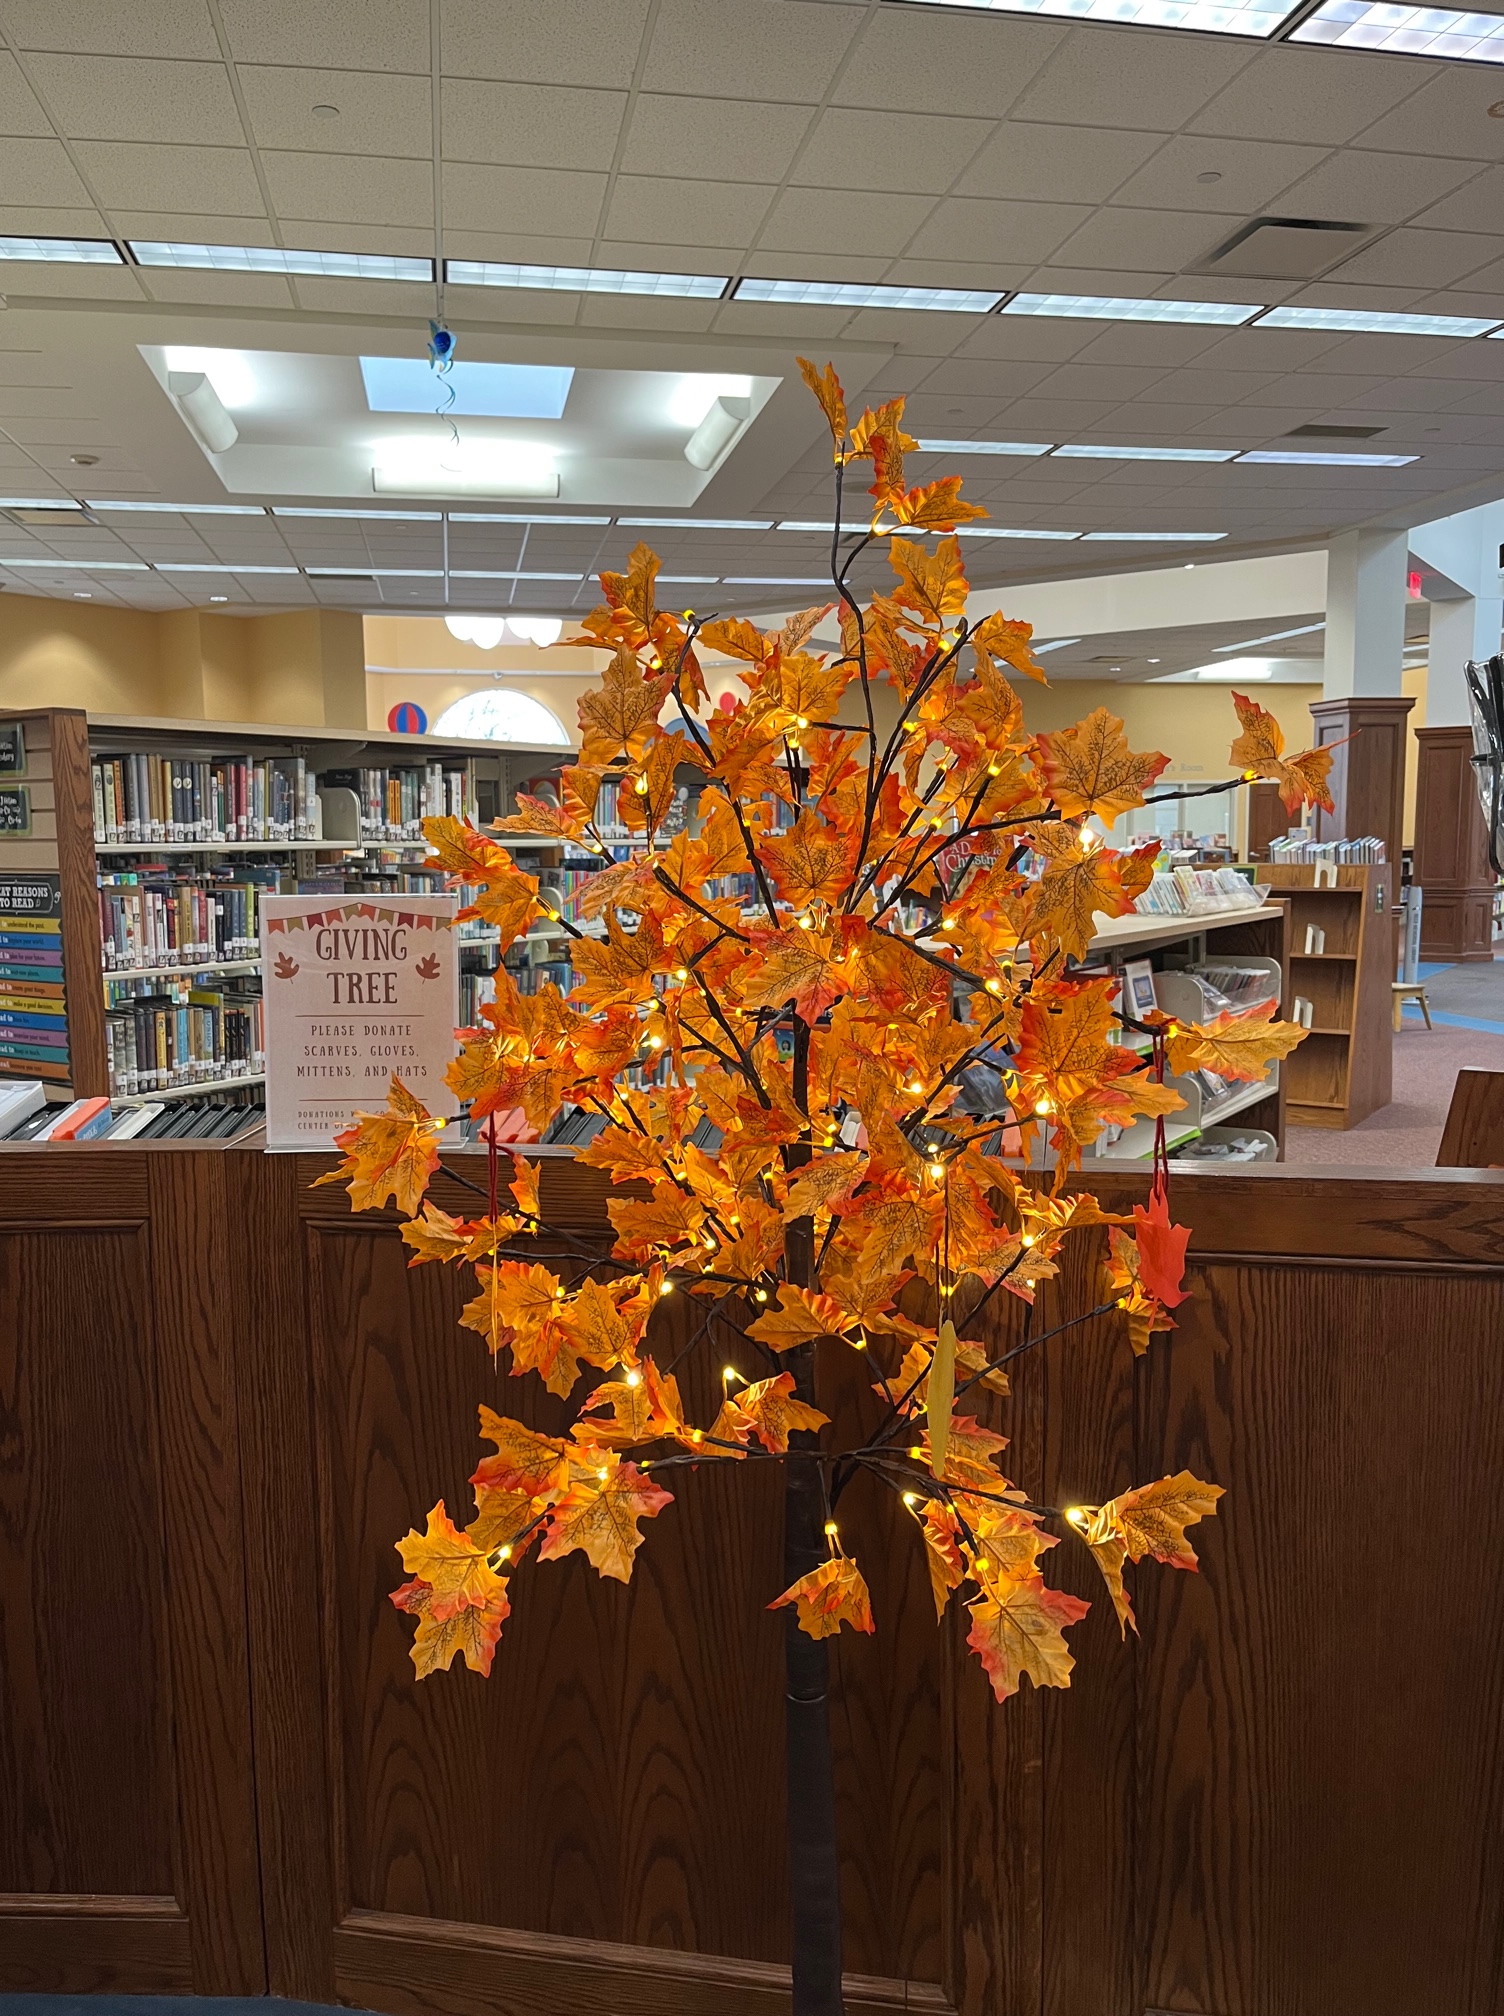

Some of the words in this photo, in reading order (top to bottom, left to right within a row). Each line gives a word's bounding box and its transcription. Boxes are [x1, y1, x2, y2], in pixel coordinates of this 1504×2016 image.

[12, 887, 49, 898] REASONS
[12, 898, 34, 908] READ
[316, 928, 408, 961] GIVING
[326, 972, 398, 1004] TREE
[311, 1025, 355, 1036] PLEASE
[364, 1025, 412, 1036] DONATE
[304, 1045, 362, 1057] SCARVES,
[370, 1045, 420, 1057] GLOVES,
[296, 1066, 356, 1077] MITTENS,
[364, 1066, 388, 1077] AND
[396, 1066, 428, 1077] HATS
[298, 1110, 345, 1118] DONATIONS
[297, 1122, 329, 1130] CENTER
